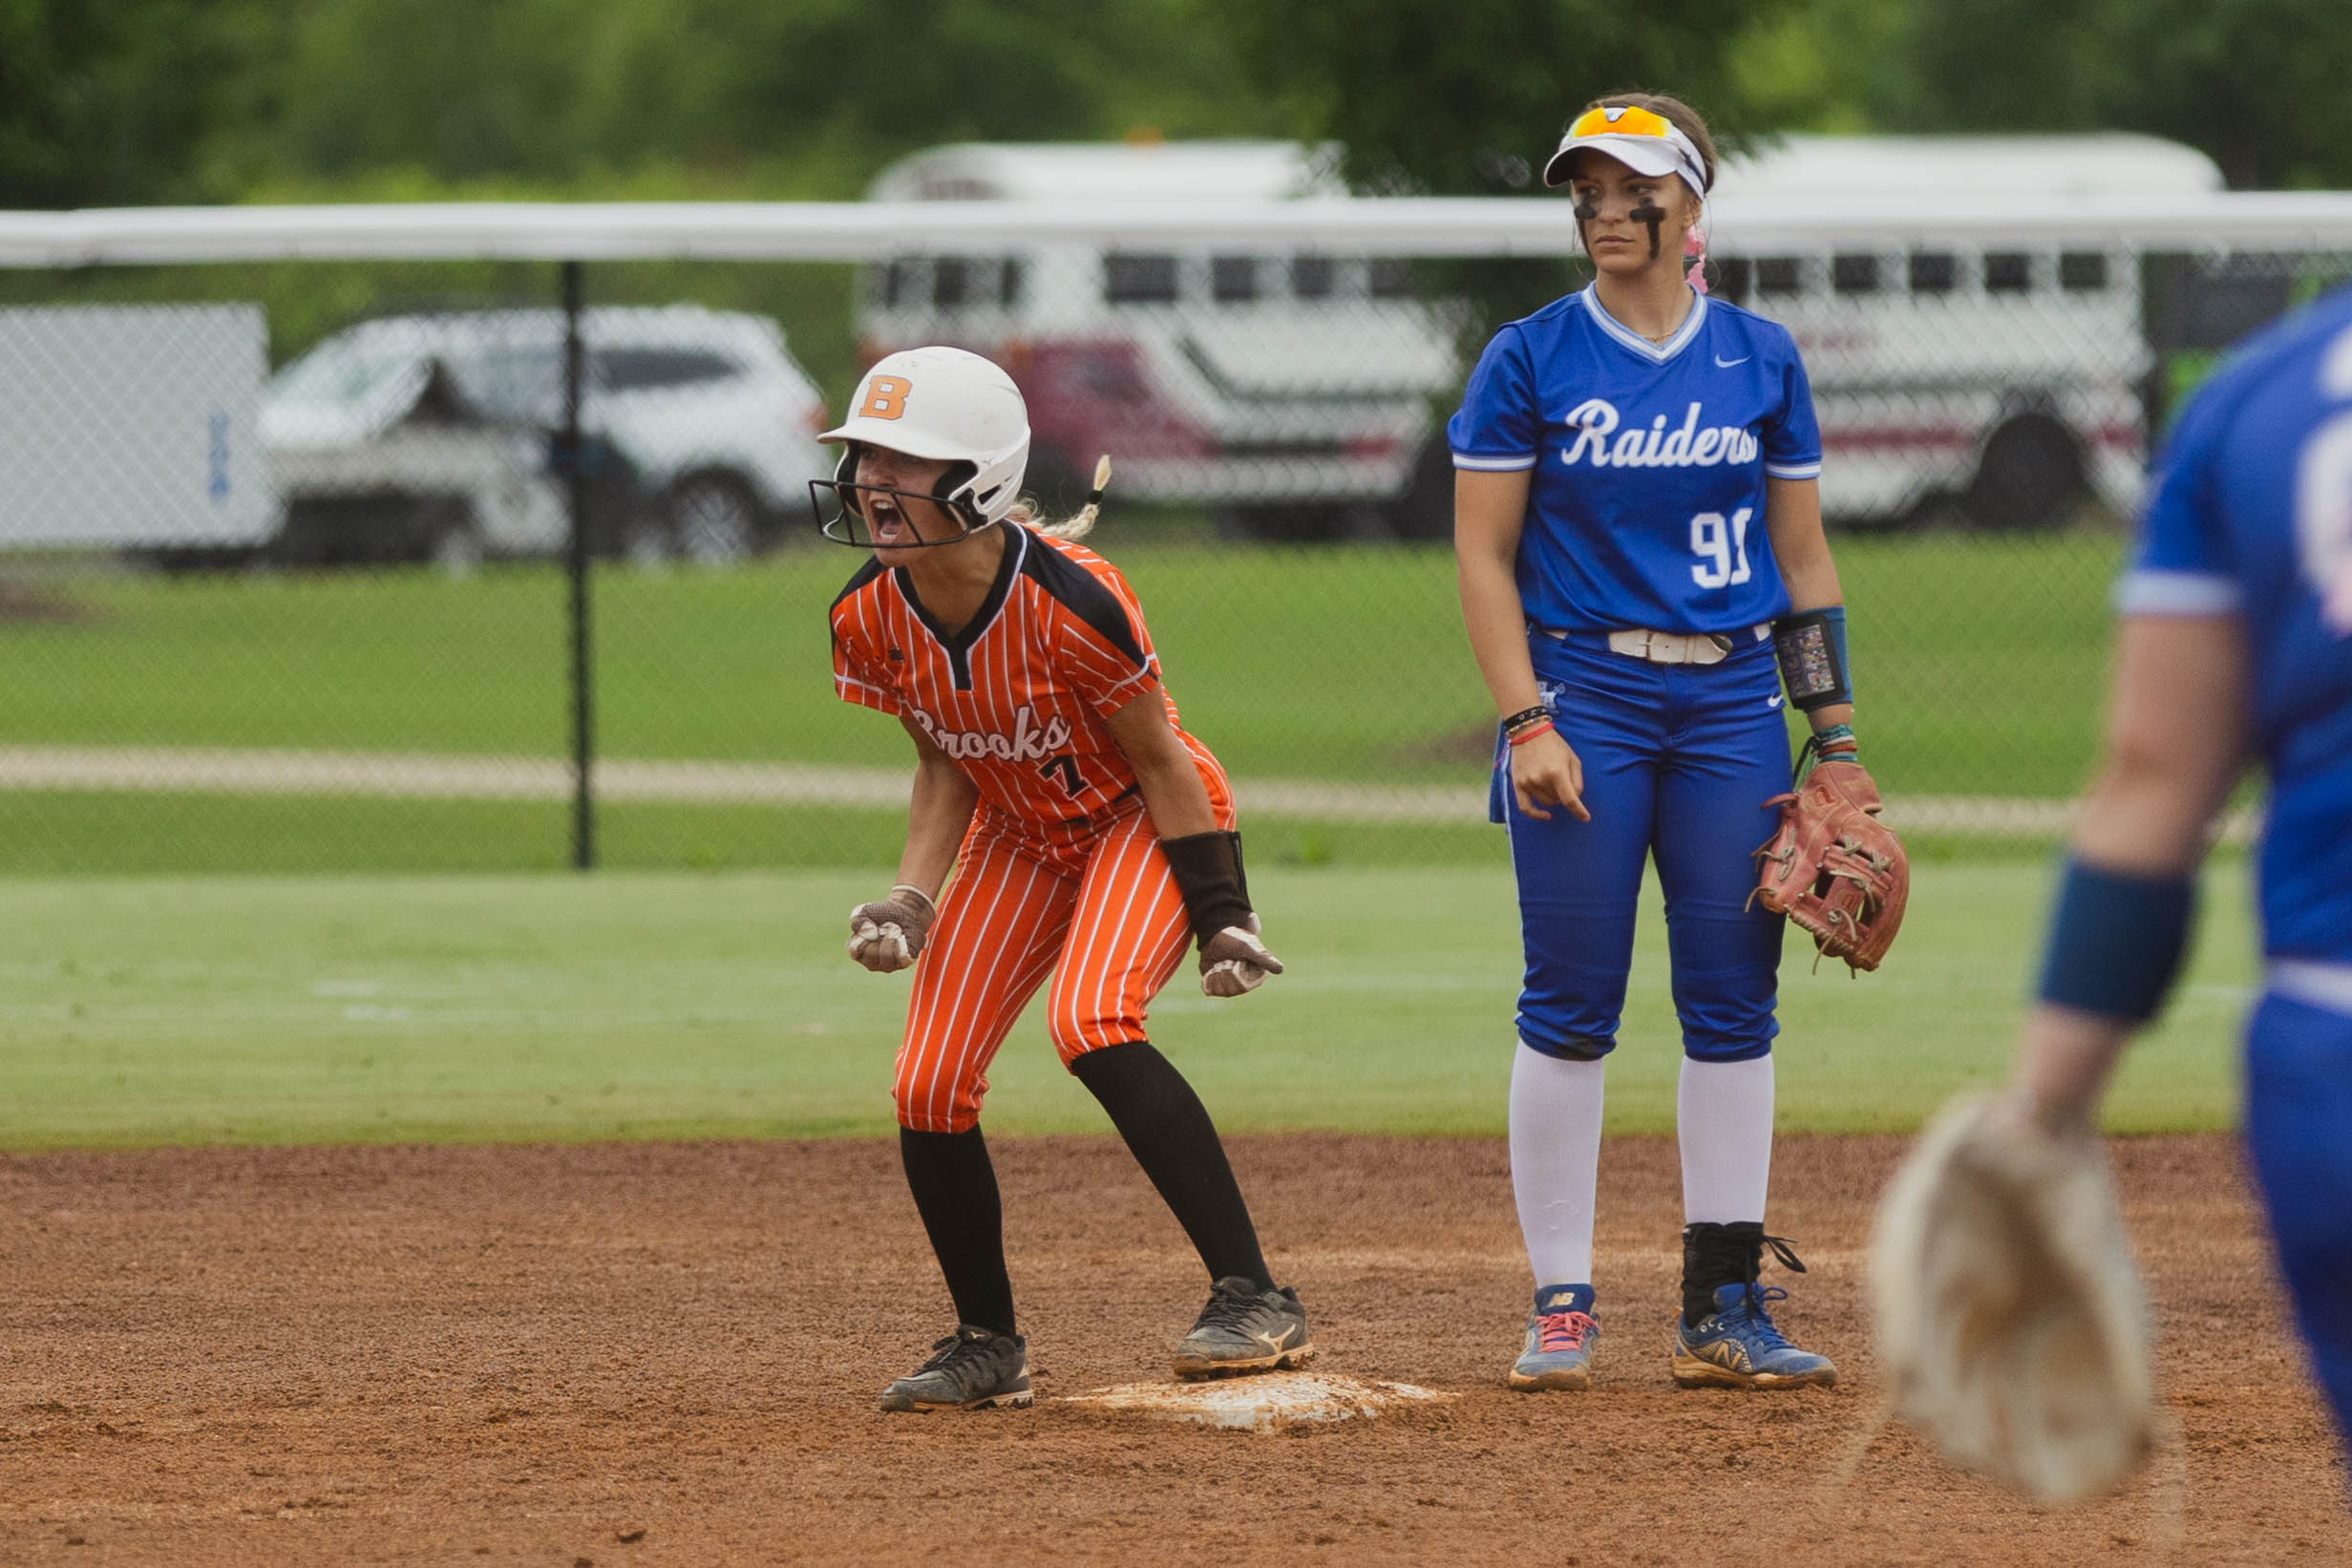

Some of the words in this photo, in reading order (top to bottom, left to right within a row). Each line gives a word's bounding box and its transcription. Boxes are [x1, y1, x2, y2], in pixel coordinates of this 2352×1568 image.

[858, 374, 913, 420] B
[1561, 398, 1758, 467] Raiders
[1035, 753, 1091, 801] 7
